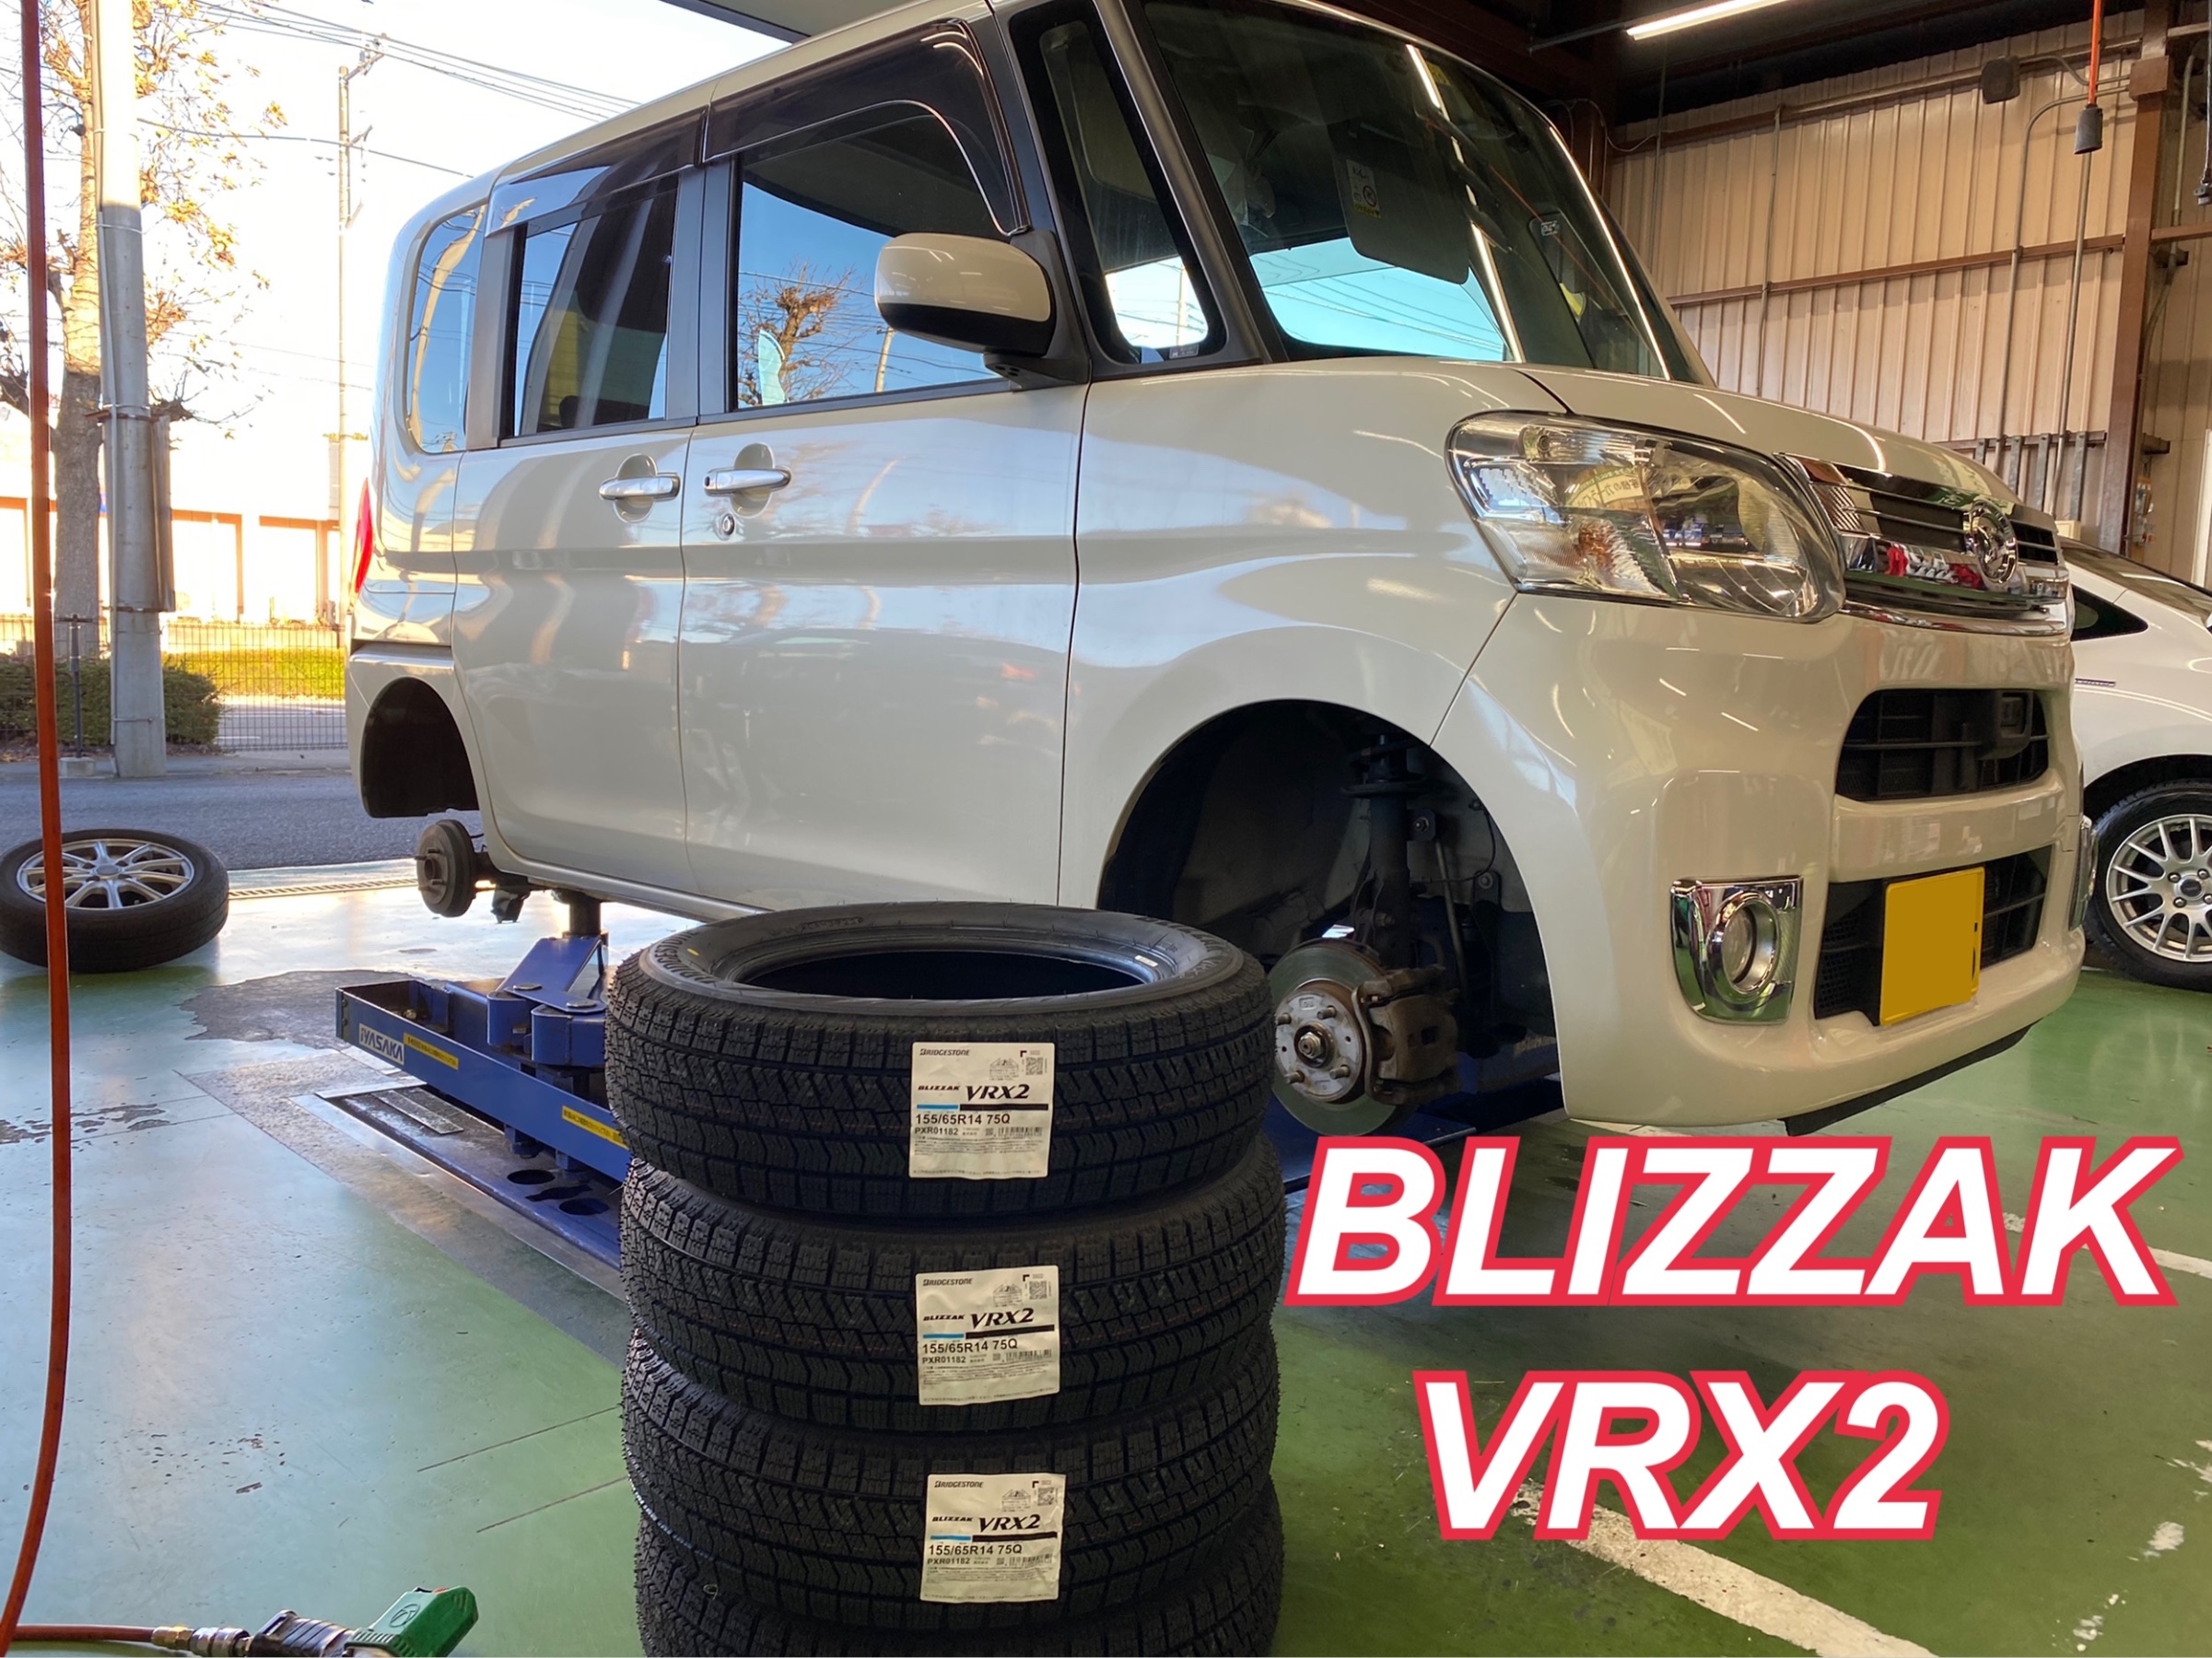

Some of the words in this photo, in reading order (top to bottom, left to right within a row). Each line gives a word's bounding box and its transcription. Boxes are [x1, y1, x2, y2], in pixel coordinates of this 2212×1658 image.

[966, 1084, 1030, 1102] VRX2
[916, 1115, 981, 1125] 155/65R14
[987, 1114, 1010, 1124] 75Q
[915, 1127, 958, 1136] PXR01182
[970, 1308, 1034, 1328] VRX2
[923, 1341, 988, 1353] 155/65R14
[993, 1338, 1018, 1350] 75Q
[922, 1356, 966, 1364] PXR01182
[978, 1514, 1041, 1532] VRX2
[929, 1545, 993, 1555] 155/65R14
[999, 1544, 1023, 1554] 75Q
